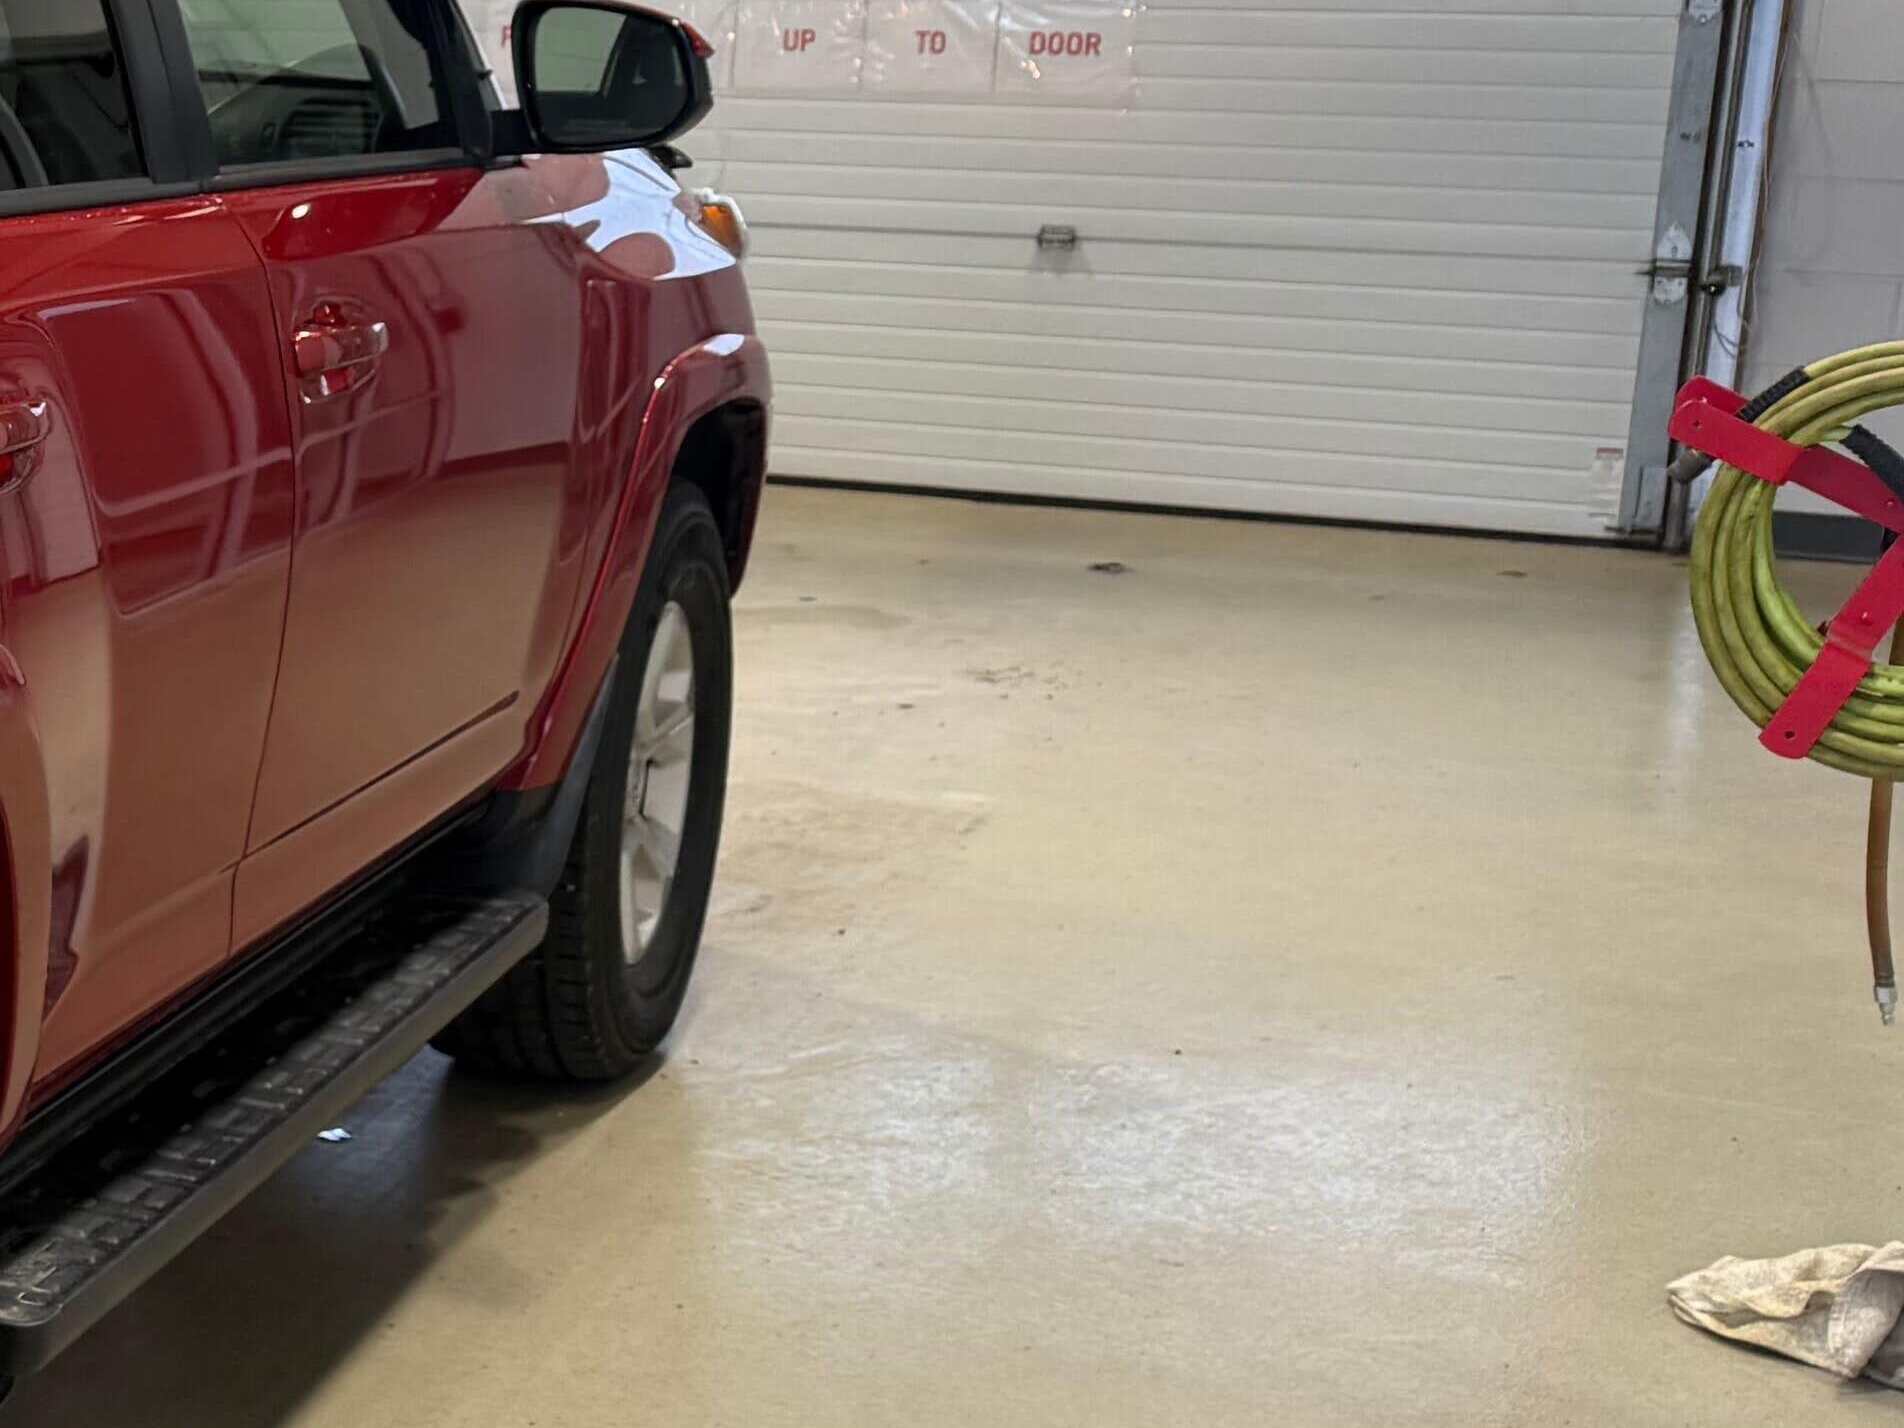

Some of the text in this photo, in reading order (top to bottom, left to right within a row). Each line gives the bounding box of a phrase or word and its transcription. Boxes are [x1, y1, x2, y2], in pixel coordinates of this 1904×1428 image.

[782, 27, 1102, 57] UP TO DOOR
